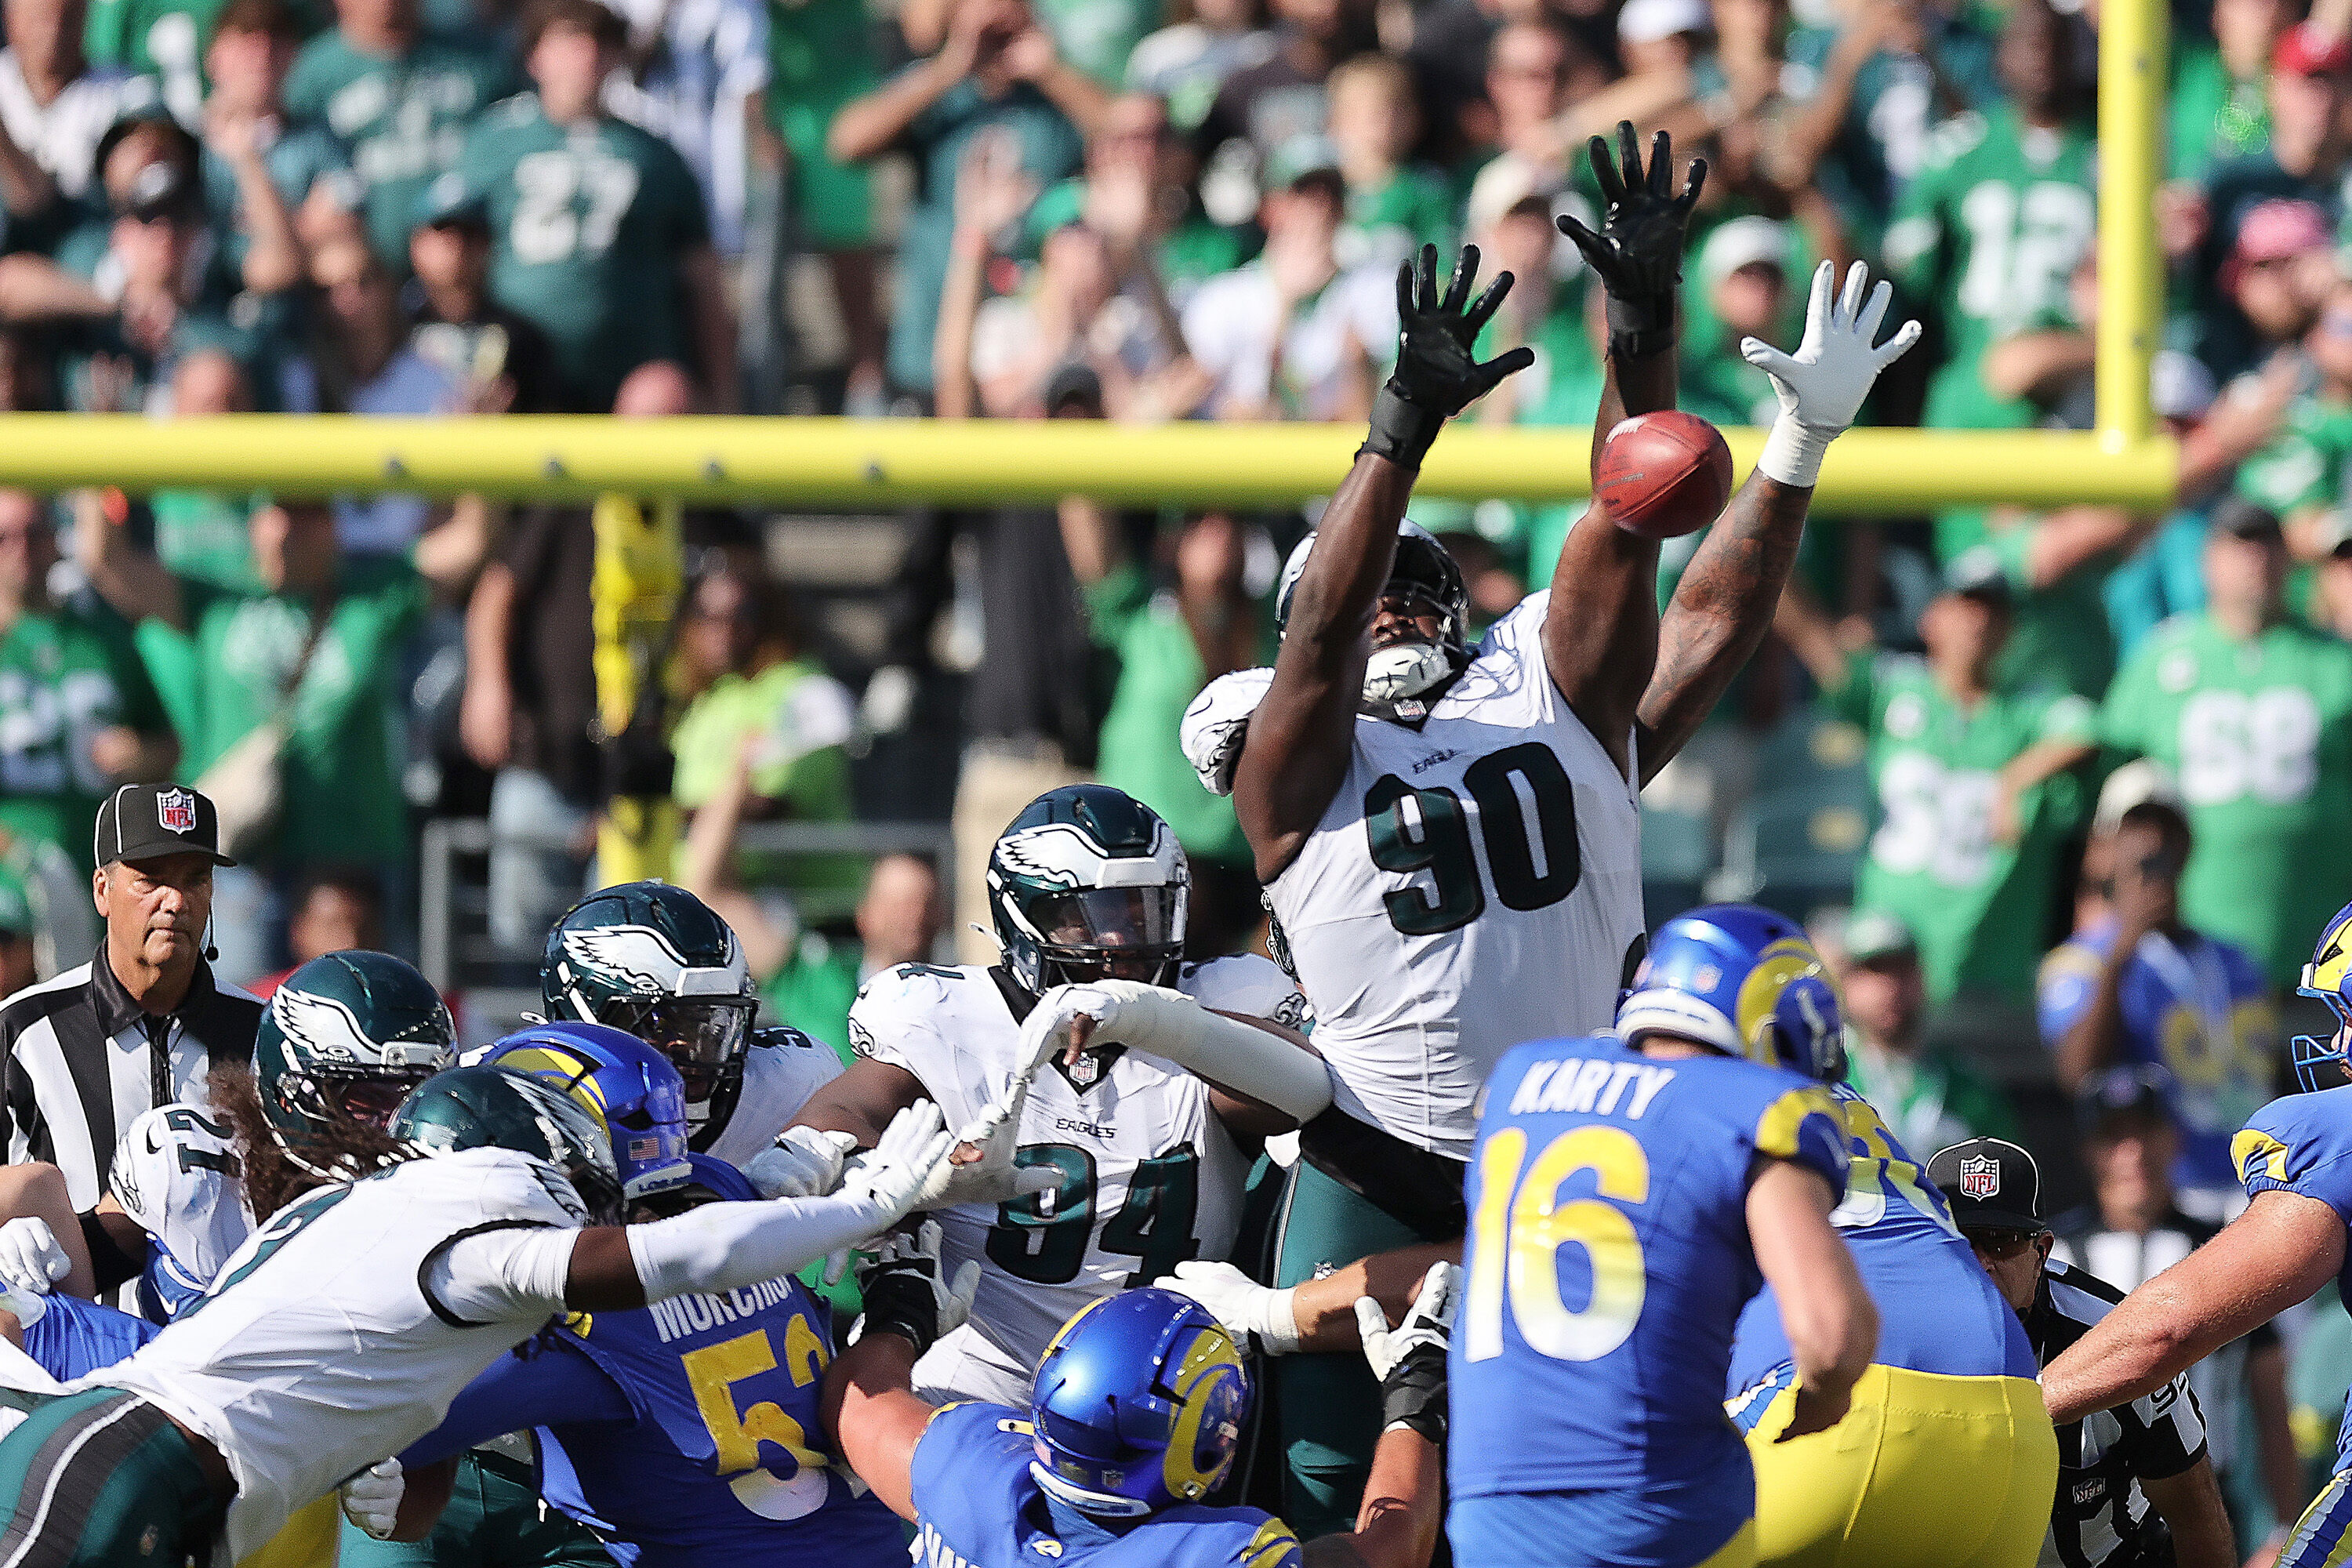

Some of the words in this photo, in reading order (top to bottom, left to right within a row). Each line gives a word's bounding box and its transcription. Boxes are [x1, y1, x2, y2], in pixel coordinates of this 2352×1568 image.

[1960, 179, 2096, 318] 12
[1364, 741, 1580, 936] 90
[1056, 1118, 1117, 1138] EAGLES
[1508, 1057, 1677, 1121] KARTY
[985, 1142, 1201, 1289] 94
[1464, 1124, 1650, 1363] 16
